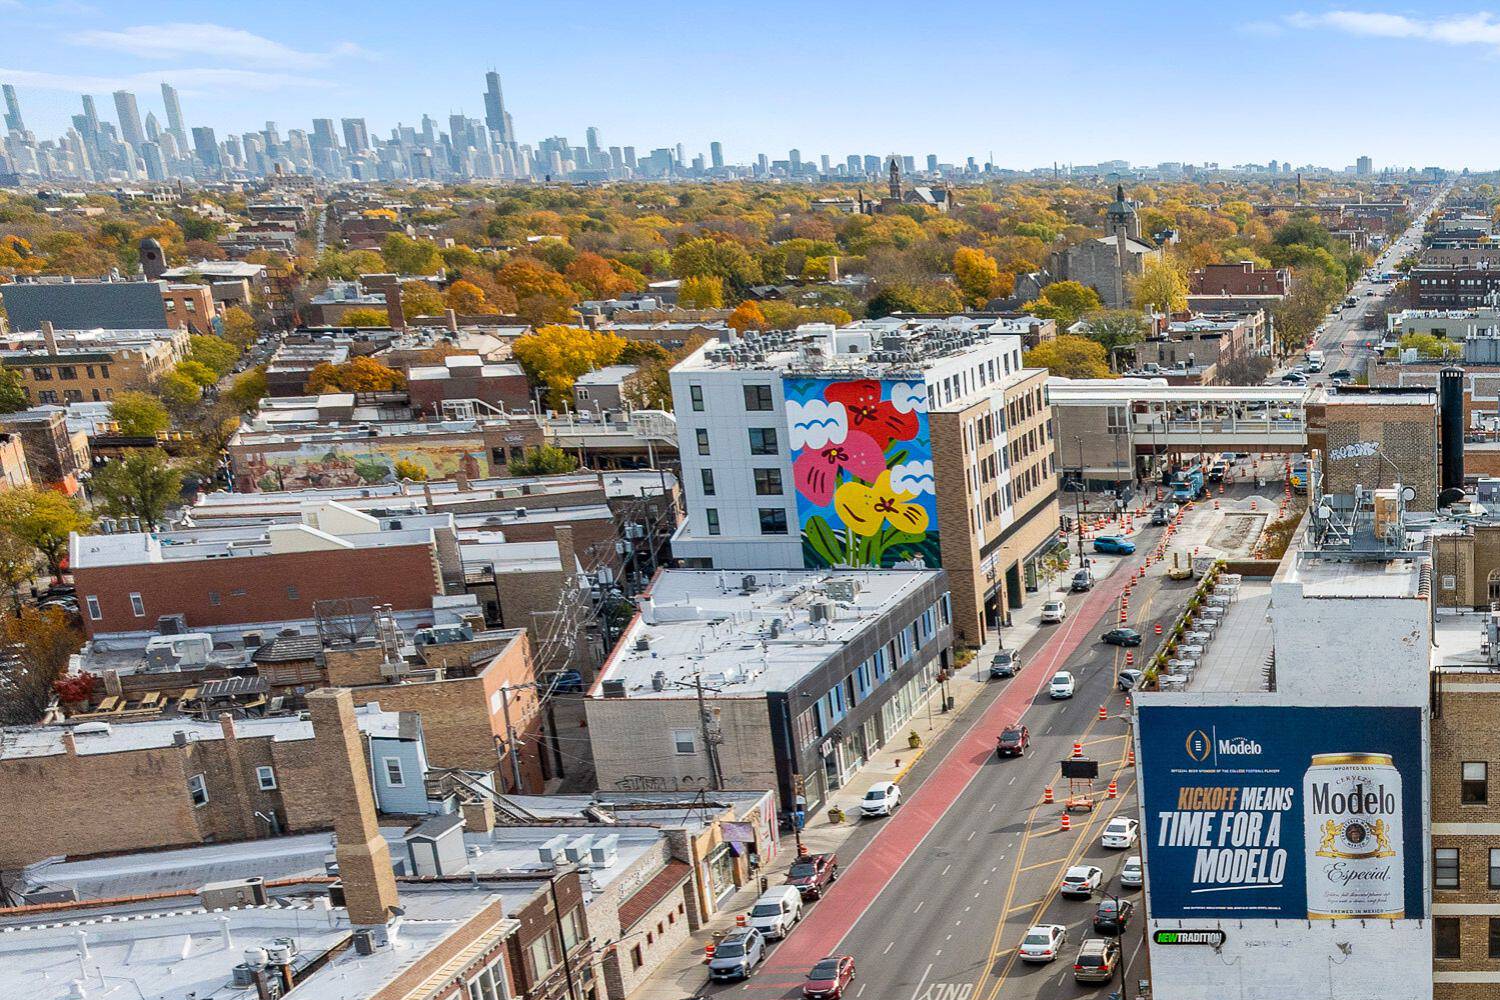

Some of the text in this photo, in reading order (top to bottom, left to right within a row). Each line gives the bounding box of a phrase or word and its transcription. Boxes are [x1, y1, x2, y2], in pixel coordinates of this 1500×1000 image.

[1218, 739, 1262, 755] Modelo
[1177, 787, 1294, 810] KICKOFF MEANS
[1312, 783, 1395, 815] Modelo
[1157, 811, 1282, 847] TIME FOR A
[1193, 848, 1288, 884] MODELO
[917, 983, 974, 1000] ONLY
